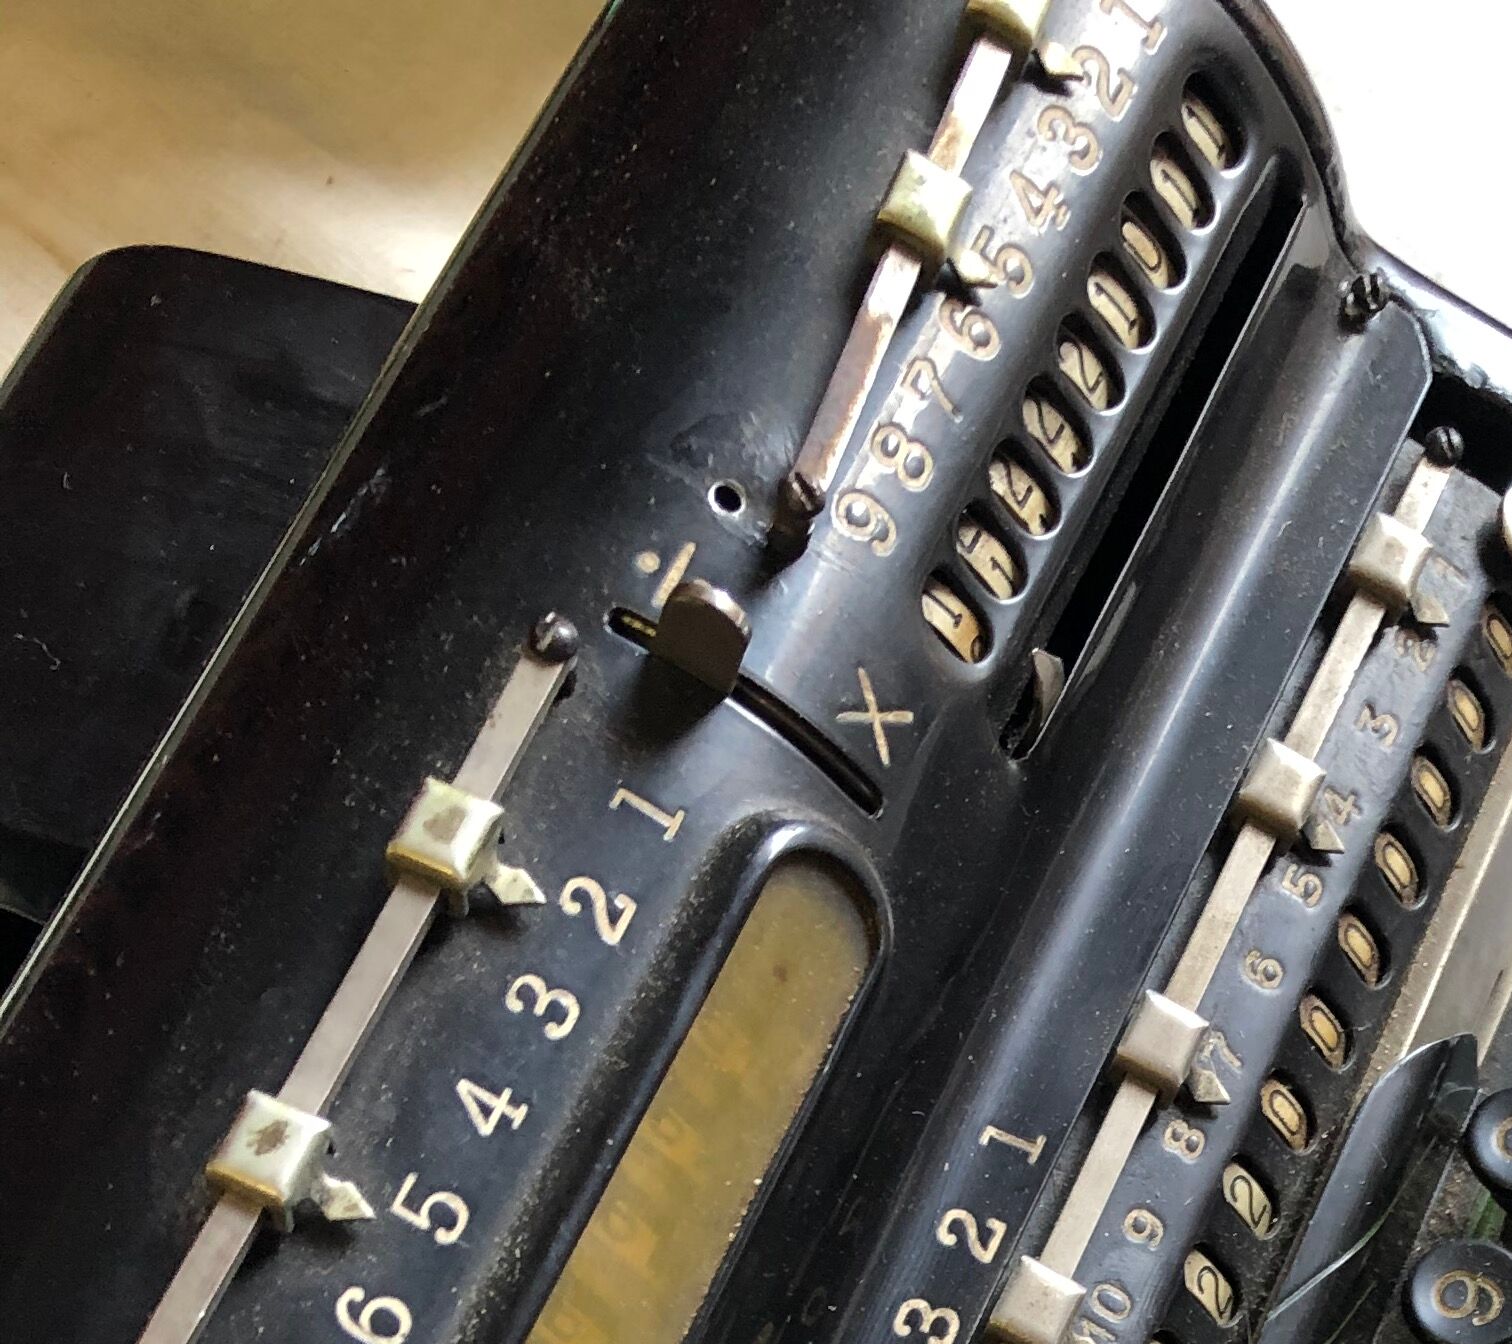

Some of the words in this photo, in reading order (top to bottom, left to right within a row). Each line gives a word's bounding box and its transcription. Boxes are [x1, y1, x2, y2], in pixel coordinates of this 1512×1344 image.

[1098, 0, 1167, 53] 1
[1071, 45, 1138, 121] 2
[1037, 104, 1102, 176] 3
[1009, 169, 1071, 232] 4
[970, 225, 1033, 299] 5
[938, 299, 1001, 361] 6
[900, 356, 964, 422] 7
[871, 422, 934, 491] 8
[830, 489, 897, 556] 9
[391, 1172, 470, 1246] 5
[455, 1078, 528, 1138] 4
[504, 973, 582, 1040] 3
[559, 876, 638, 946] 2
[608, 787, 686, 841] 1
[1121, 1207, 1165, 1251] 9
[1162, 1117, 1208, 1163] 8
[1242, 949, 1284, 991] 6
[1280, 863, 1326, 908] 5
[1321, 784, 1363, 826] 4
[935, 1207, 1008, 1264] 2
[979, 1124, 1049, 1166] 1
[1193, 1264, 1235, 1316] 2
[1229, 1172, 1273, 1228] 2
[1432, 1271, 1505, 1326] 9
